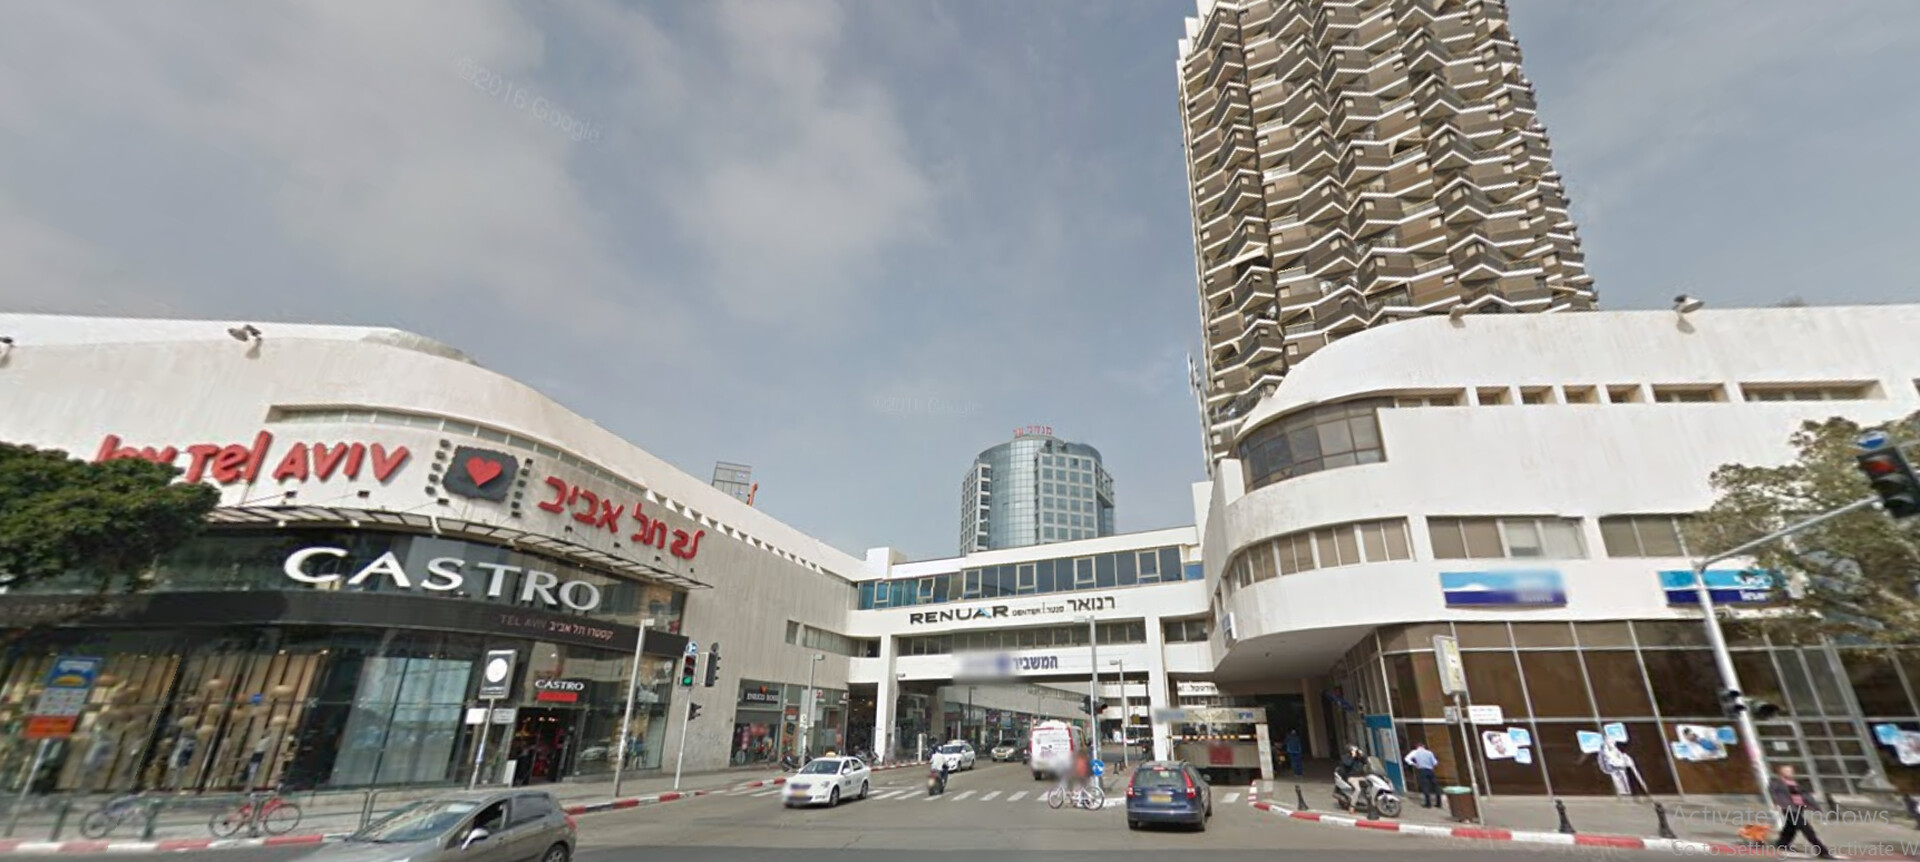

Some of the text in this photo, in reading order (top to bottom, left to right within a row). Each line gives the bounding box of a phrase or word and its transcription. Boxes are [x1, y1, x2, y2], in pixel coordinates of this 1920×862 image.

[272, 441, 410, 484] AVIV
[537, 475, 624, 534] אביב
[631, 502, 667, 550] תל
[283, 546, 600, 612] CASTRO
[909, 605, 1009, 625] RENUAR
[1067, 595, 1115, 612] רנואר
[534, 679, 585, 691] CASTRO
